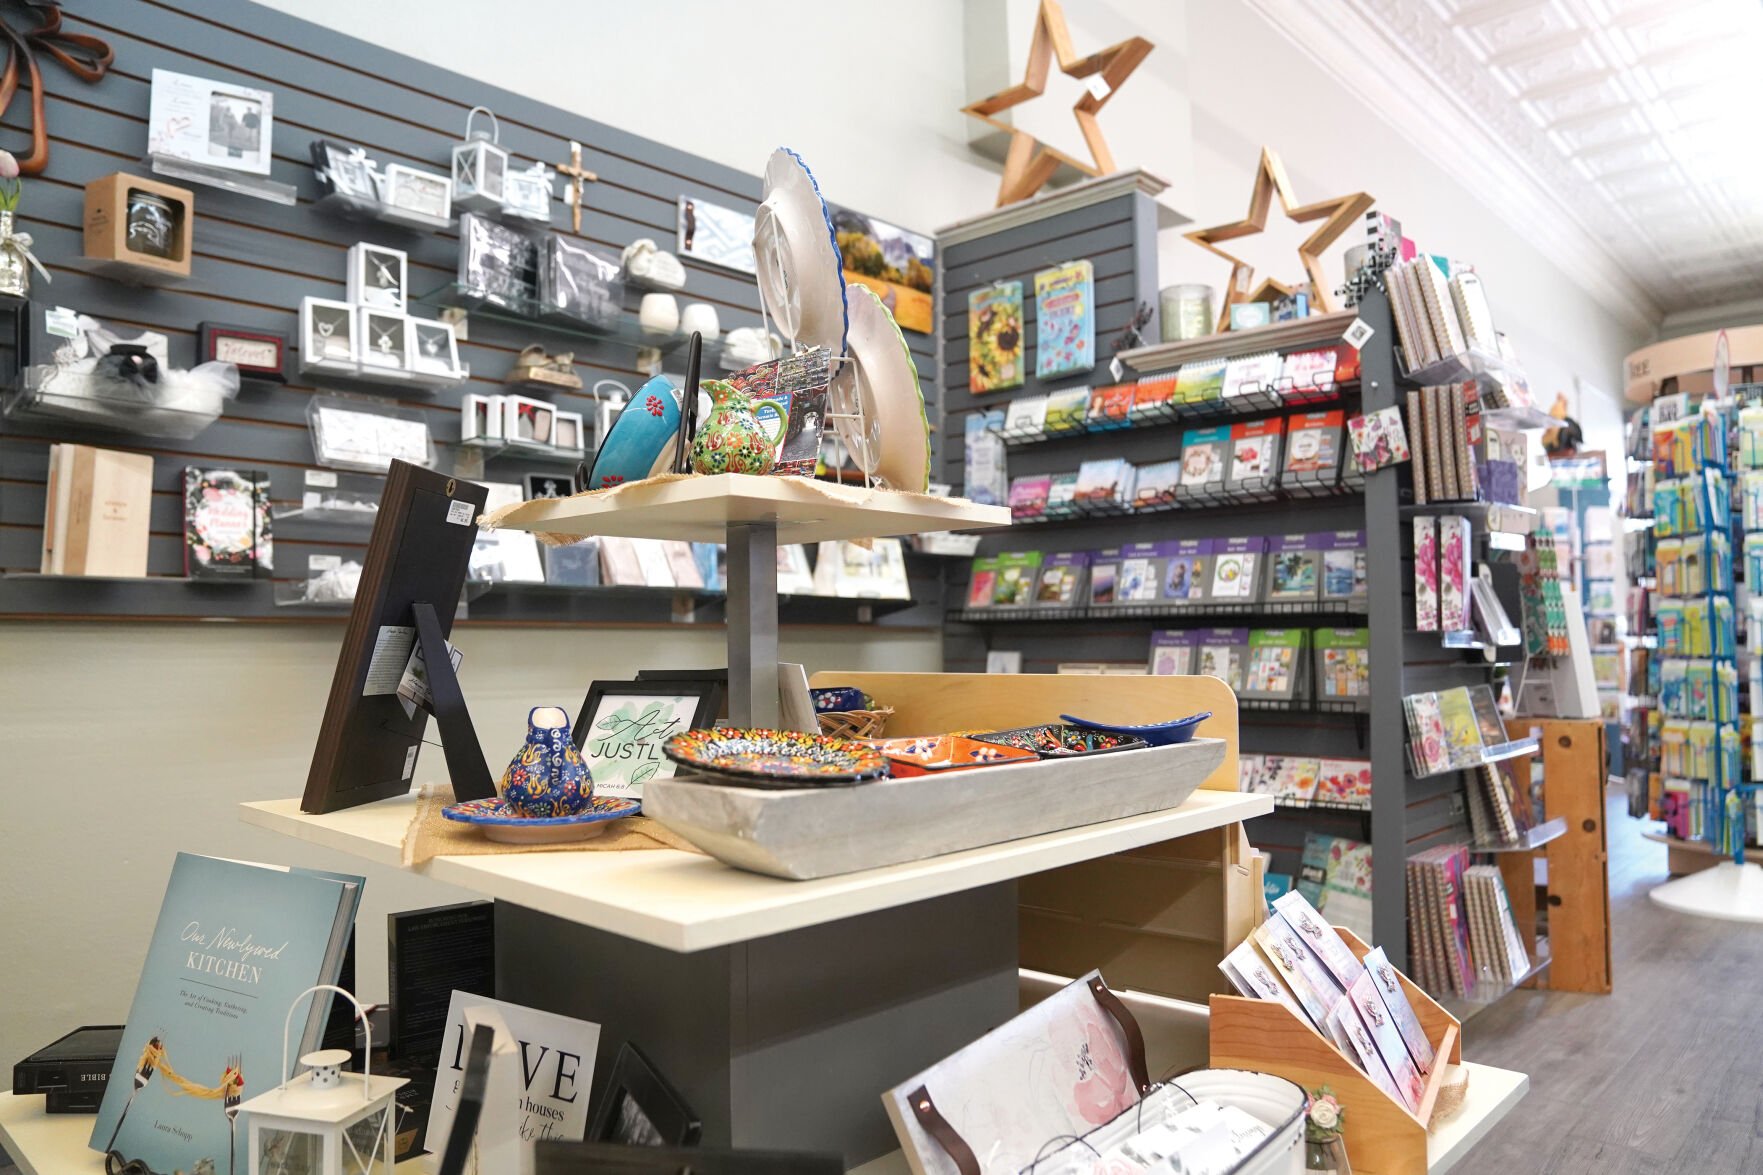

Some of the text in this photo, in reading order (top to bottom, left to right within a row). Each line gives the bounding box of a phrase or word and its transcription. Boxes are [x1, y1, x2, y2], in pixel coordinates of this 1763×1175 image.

[597, 709, 681, 742] Act
[591, 742, 670, 761] JUSTL
[180, 921, 289, 962] Our Newlywed
[185, 951, 263, 985] KITCHEN
[80, 1073, 106, 1082] BIBLE
[525, 1096, 565, 1122] houses
[153, 1119, 171, 1133] Laura
[519, 1115, 535, 1142] ike
